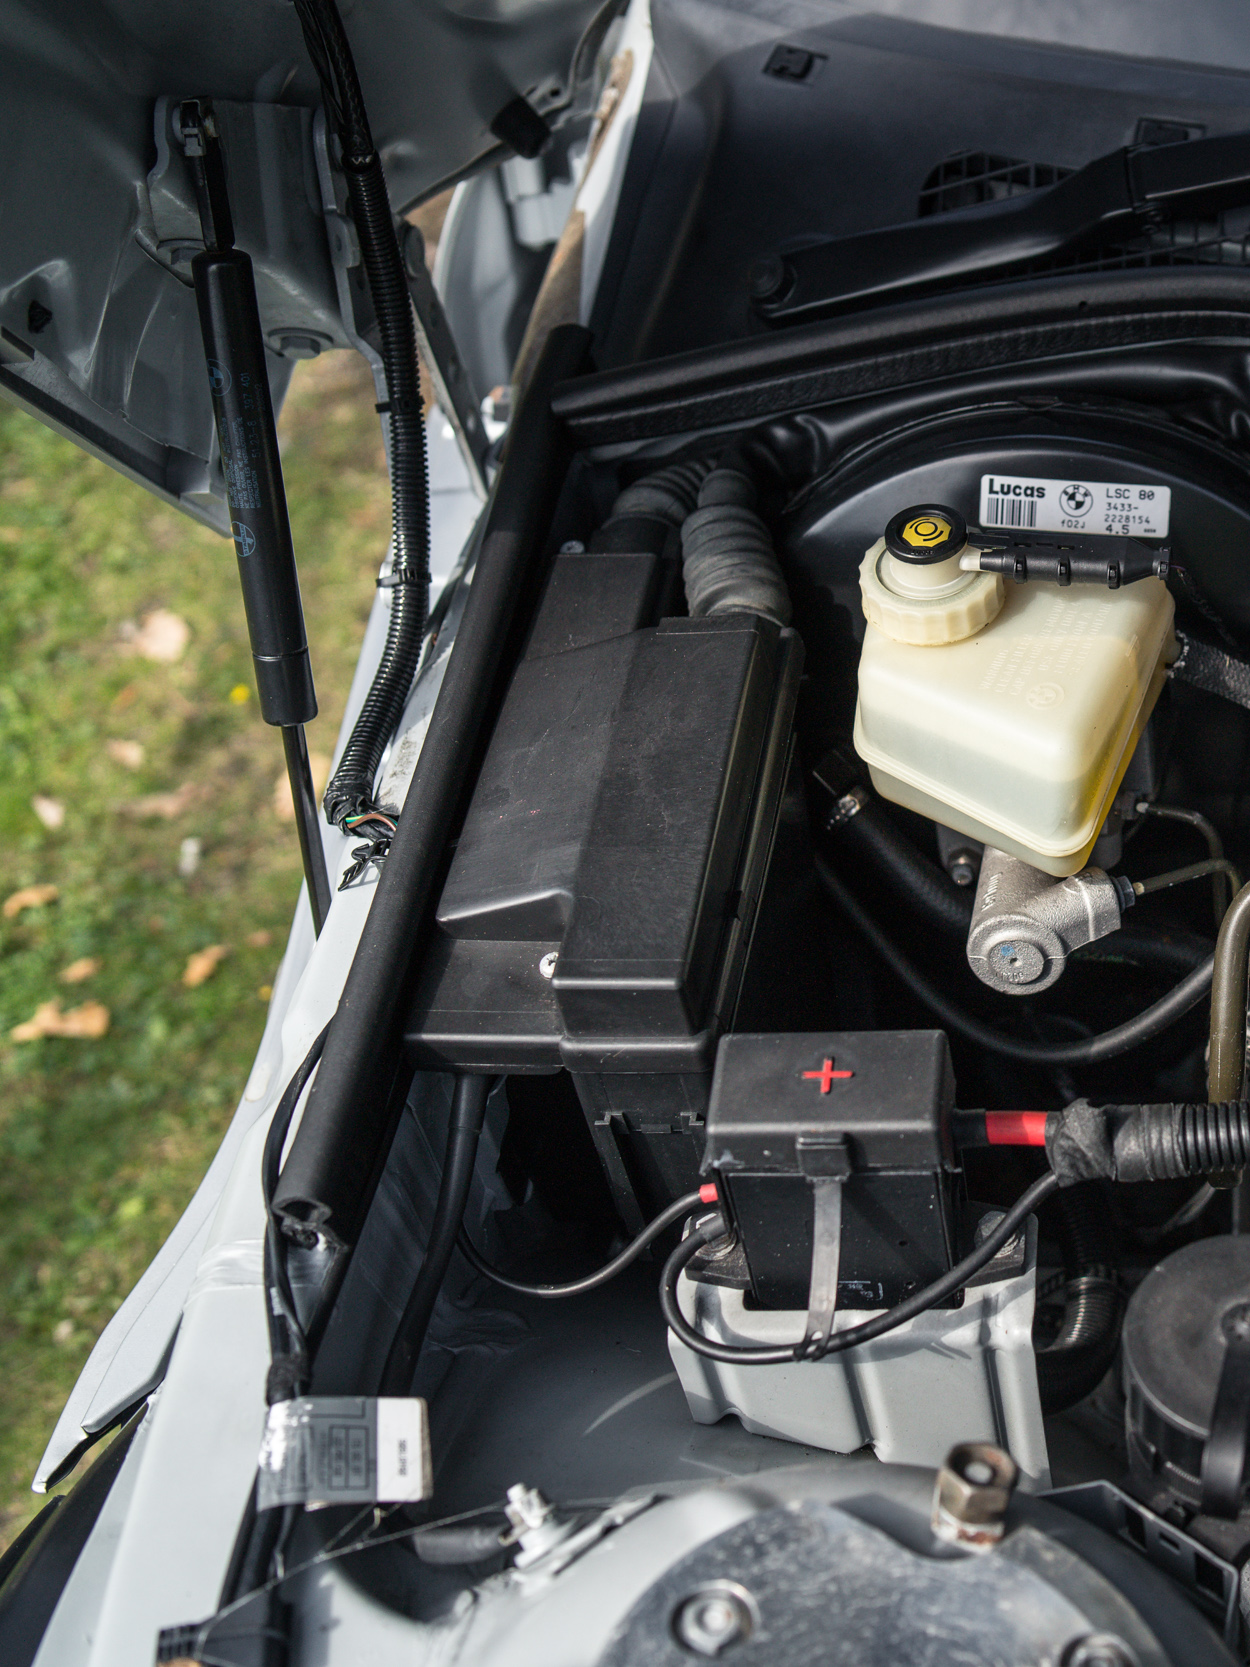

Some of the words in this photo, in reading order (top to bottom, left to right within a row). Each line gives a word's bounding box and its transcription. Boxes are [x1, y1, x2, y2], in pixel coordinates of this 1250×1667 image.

[988, 478, 1046, 498] Lucas
[1106, 488, 1131, 499] LSC
[1138, 490, 1155, 501] 80
[1106, 502, 1139, 512] 3433-
[1104, 514, 1151, 525] 2228154
[1105, 524, 1130, 535] 4.5
